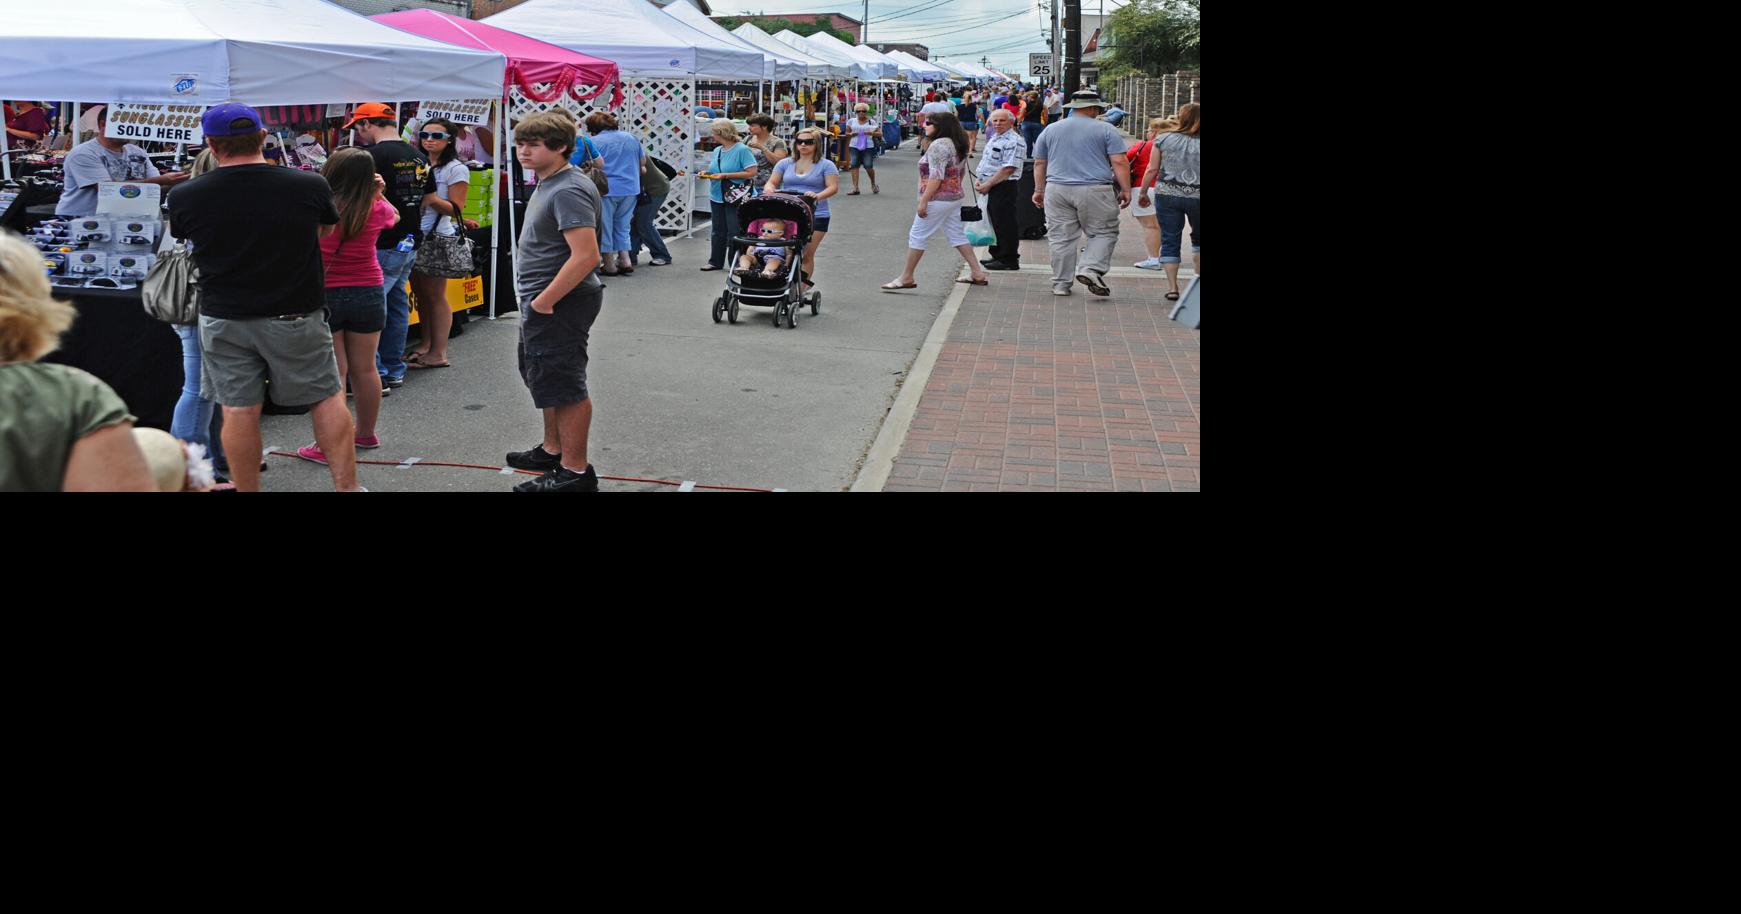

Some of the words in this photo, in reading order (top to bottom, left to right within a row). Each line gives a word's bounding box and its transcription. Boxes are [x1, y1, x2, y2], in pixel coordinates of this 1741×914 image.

[1033, 66, 1050, 75] 25
[110, 111, 202, 129] SUNGLASSES
[454, 113, 481, 123] HERE
[117, 125, 152, 138] SOLD
[157, 128, 192, 141] HERE
